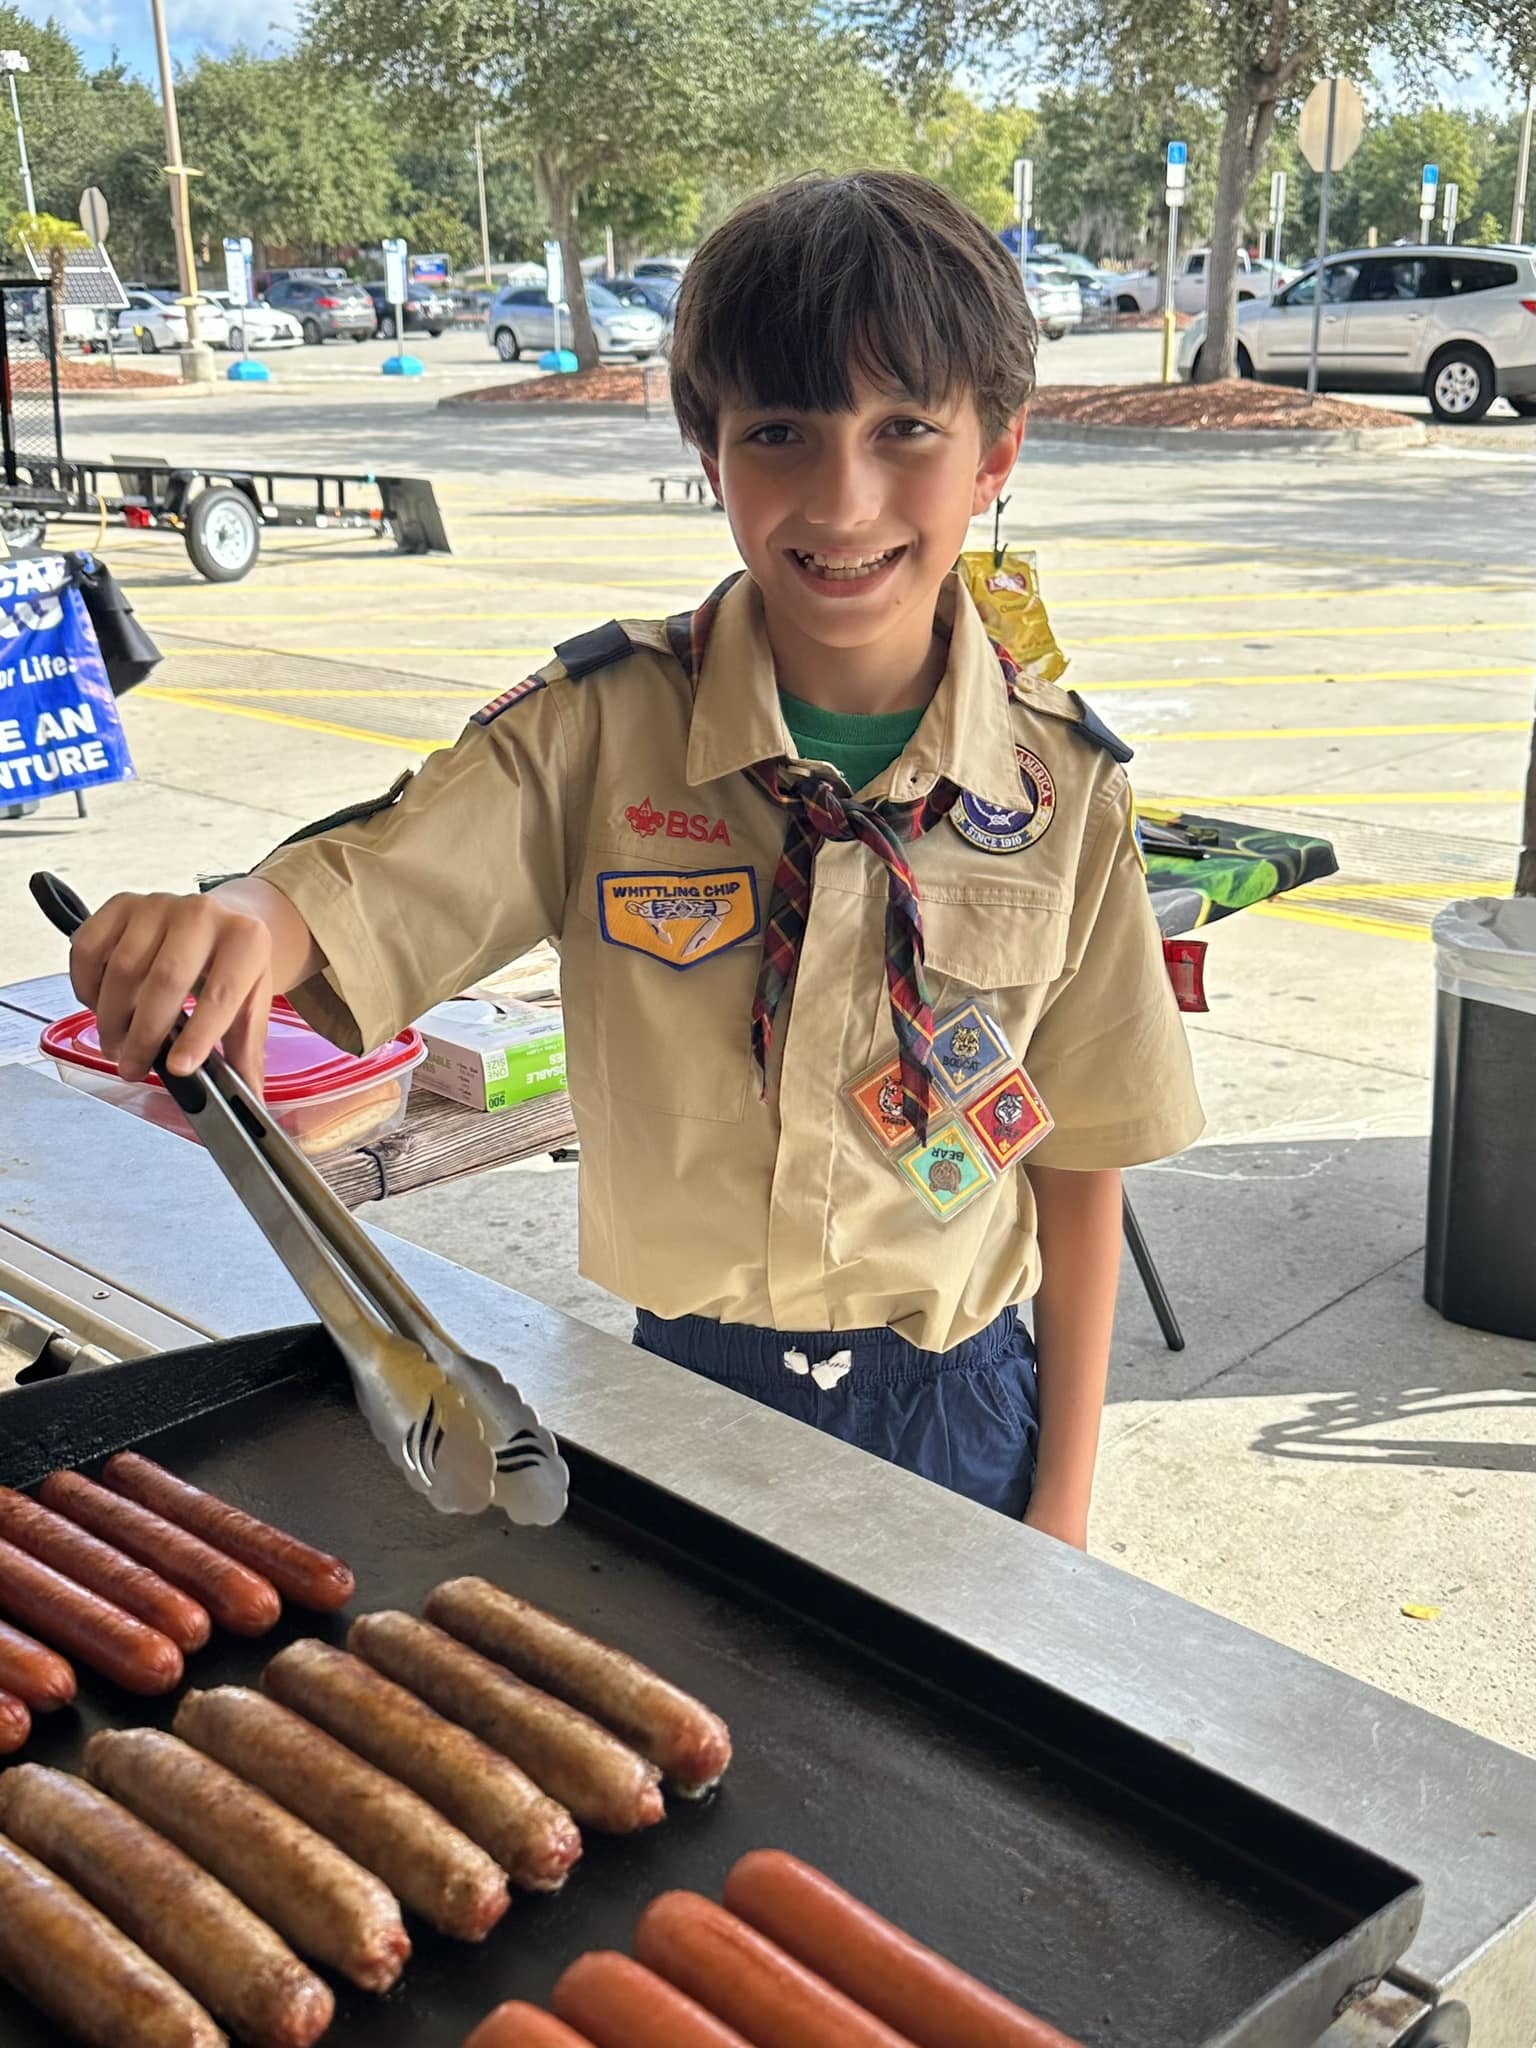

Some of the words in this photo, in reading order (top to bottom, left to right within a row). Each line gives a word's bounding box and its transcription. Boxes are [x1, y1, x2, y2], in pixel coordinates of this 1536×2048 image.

[35, 702, 97, 747] AN
[666, 810, 732, 847] BSA
[966, 826, 997, 847] SINCE
[1000, 834, 1022, 848] 1910
[612, 885, 700, 898] WHITTLING
[703, 881, 741, 897] CHIP
[489, 1095, 506, 1109] 500
[931, 1147, 965, 1162] BEAR
